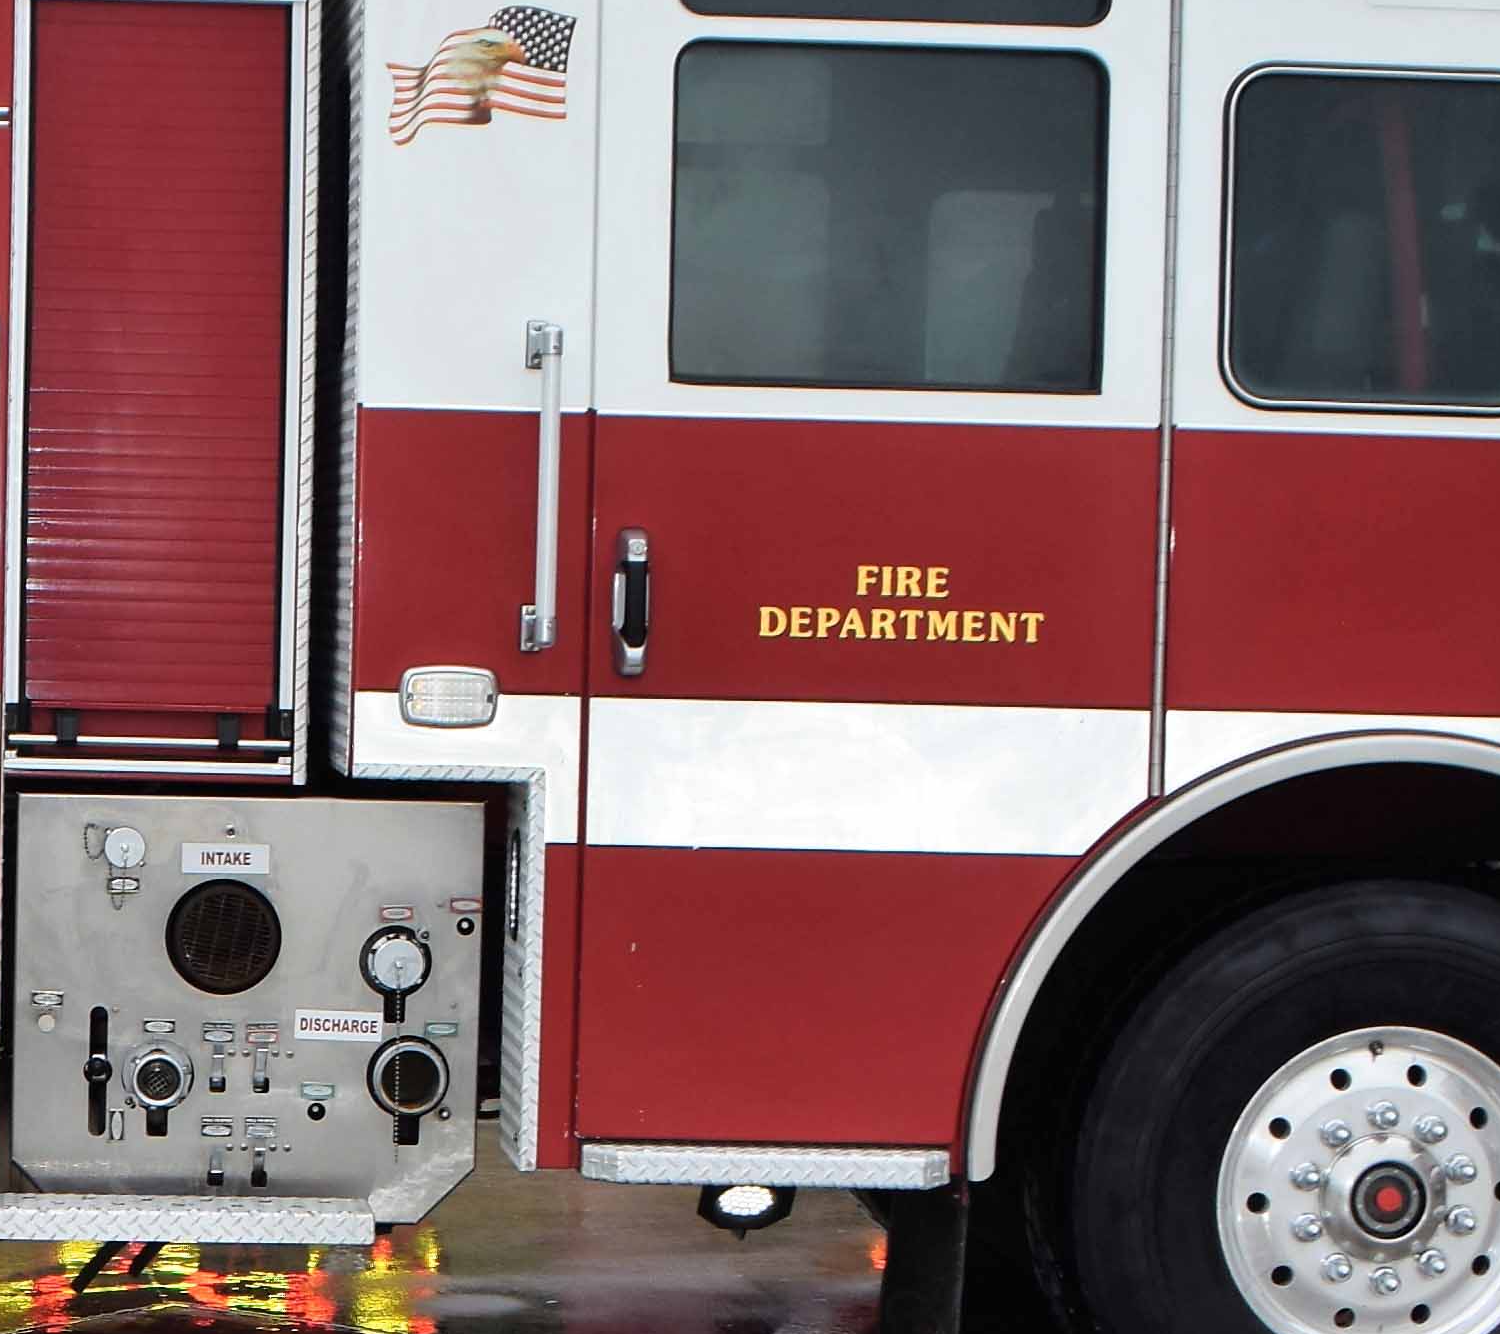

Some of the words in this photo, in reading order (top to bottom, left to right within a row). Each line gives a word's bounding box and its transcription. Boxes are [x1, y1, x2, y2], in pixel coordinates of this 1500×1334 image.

[855, 565, 950, 598] FIRE
[758, 606, 1046, 644] DEPARTMENT
[200, 852, 252, 866] INTAKE
[299, 1017, 379, 1035] DISCHARGE
